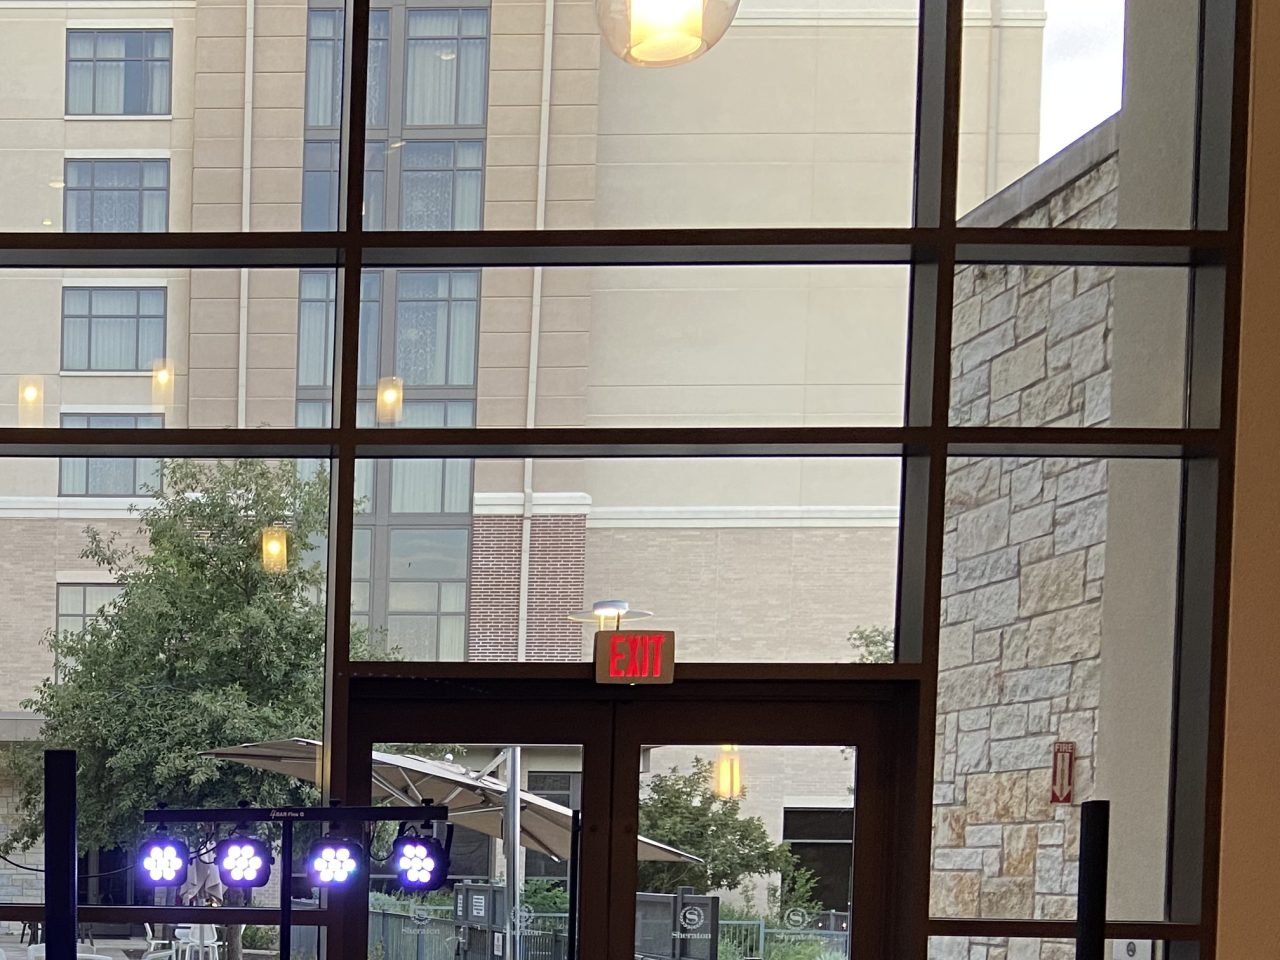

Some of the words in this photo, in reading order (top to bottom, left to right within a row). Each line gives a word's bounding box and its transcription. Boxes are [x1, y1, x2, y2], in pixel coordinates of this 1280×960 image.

[609, 634, 665, 677] EXIT
[1055, 743, 1074, 753] FIRE
[671, 930, 712, 939] Sheraton
